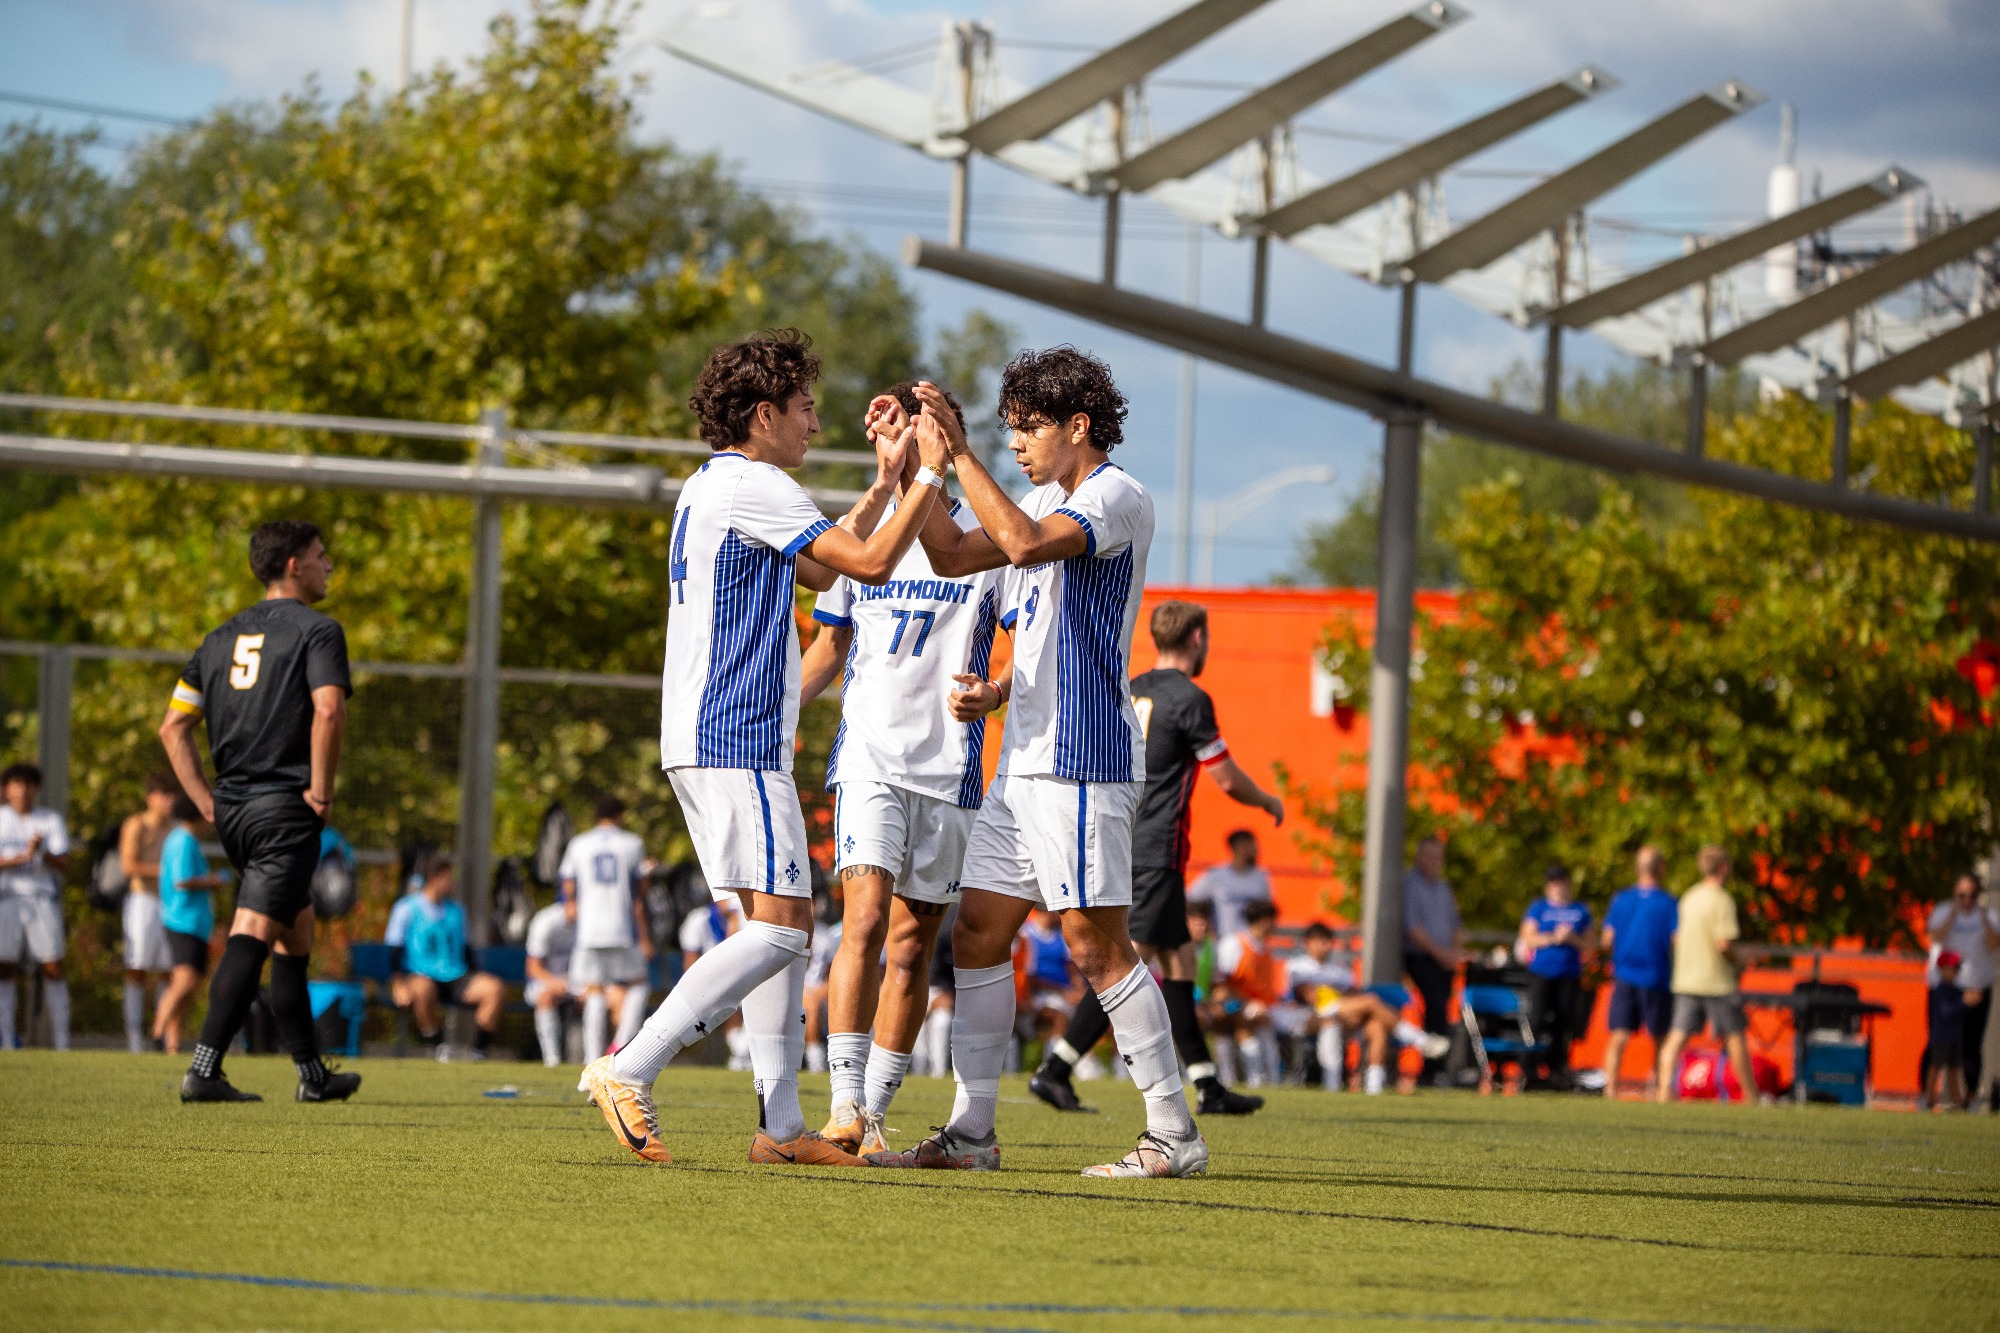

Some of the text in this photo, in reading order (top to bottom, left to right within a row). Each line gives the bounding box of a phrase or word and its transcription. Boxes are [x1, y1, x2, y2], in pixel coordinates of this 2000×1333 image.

[668, 505, 688, 607] 4
[859, 580, 975, 604] MARYMOUNT
[1025, 585, 1040, 631] 9
[888, 610, 936, 657] 77
[229, 633, 265, 690] 5
